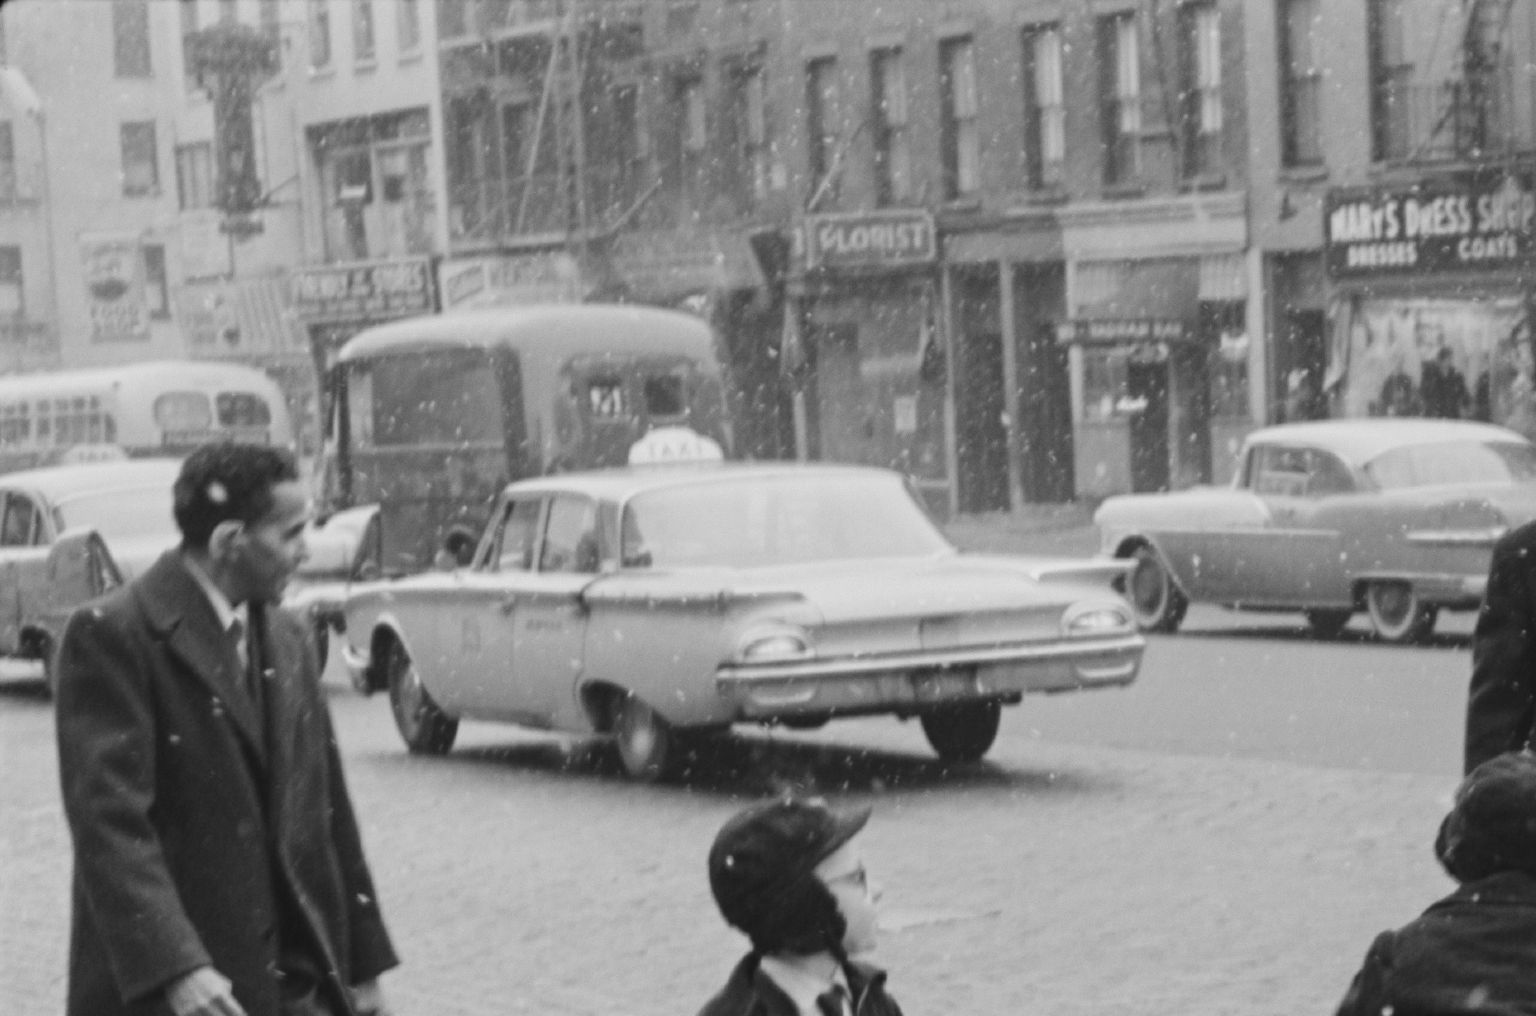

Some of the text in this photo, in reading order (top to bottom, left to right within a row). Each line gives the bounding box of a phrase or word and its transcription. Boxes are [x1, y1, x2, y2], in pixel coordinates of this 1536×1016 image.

[1405, 195, 1473, 237] DRESS
[820, 223, 925, 253] FLORIST
[1348, 234, 1518, 267] DRESSES COATS
